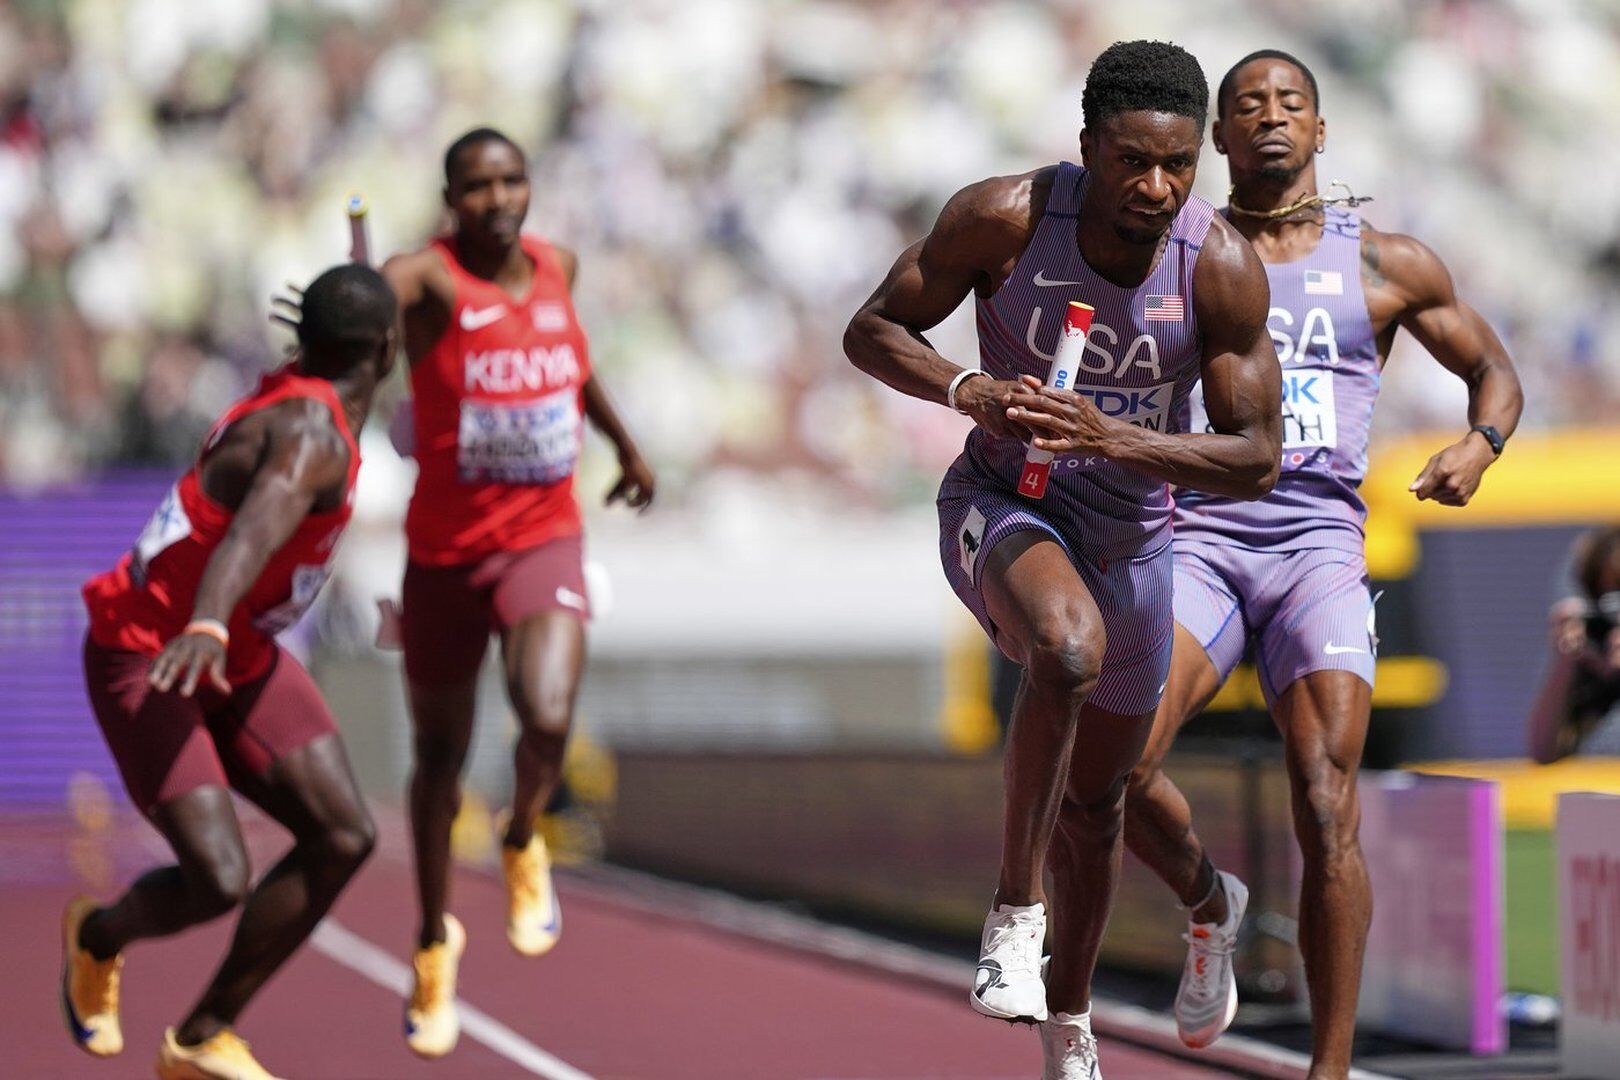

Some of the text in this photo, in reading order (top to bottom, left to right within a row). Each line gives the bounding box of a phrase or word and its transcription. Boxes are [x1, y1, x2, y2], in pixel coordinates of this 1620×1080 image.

[1027, 306, 1161, 380] USA
[1267, 307, 1339, 364] SA
[464, 344, 580, 393] KENYA
[1025, 472, 1039, 490] 4
[1051, 456, 1108, 470] TOK
